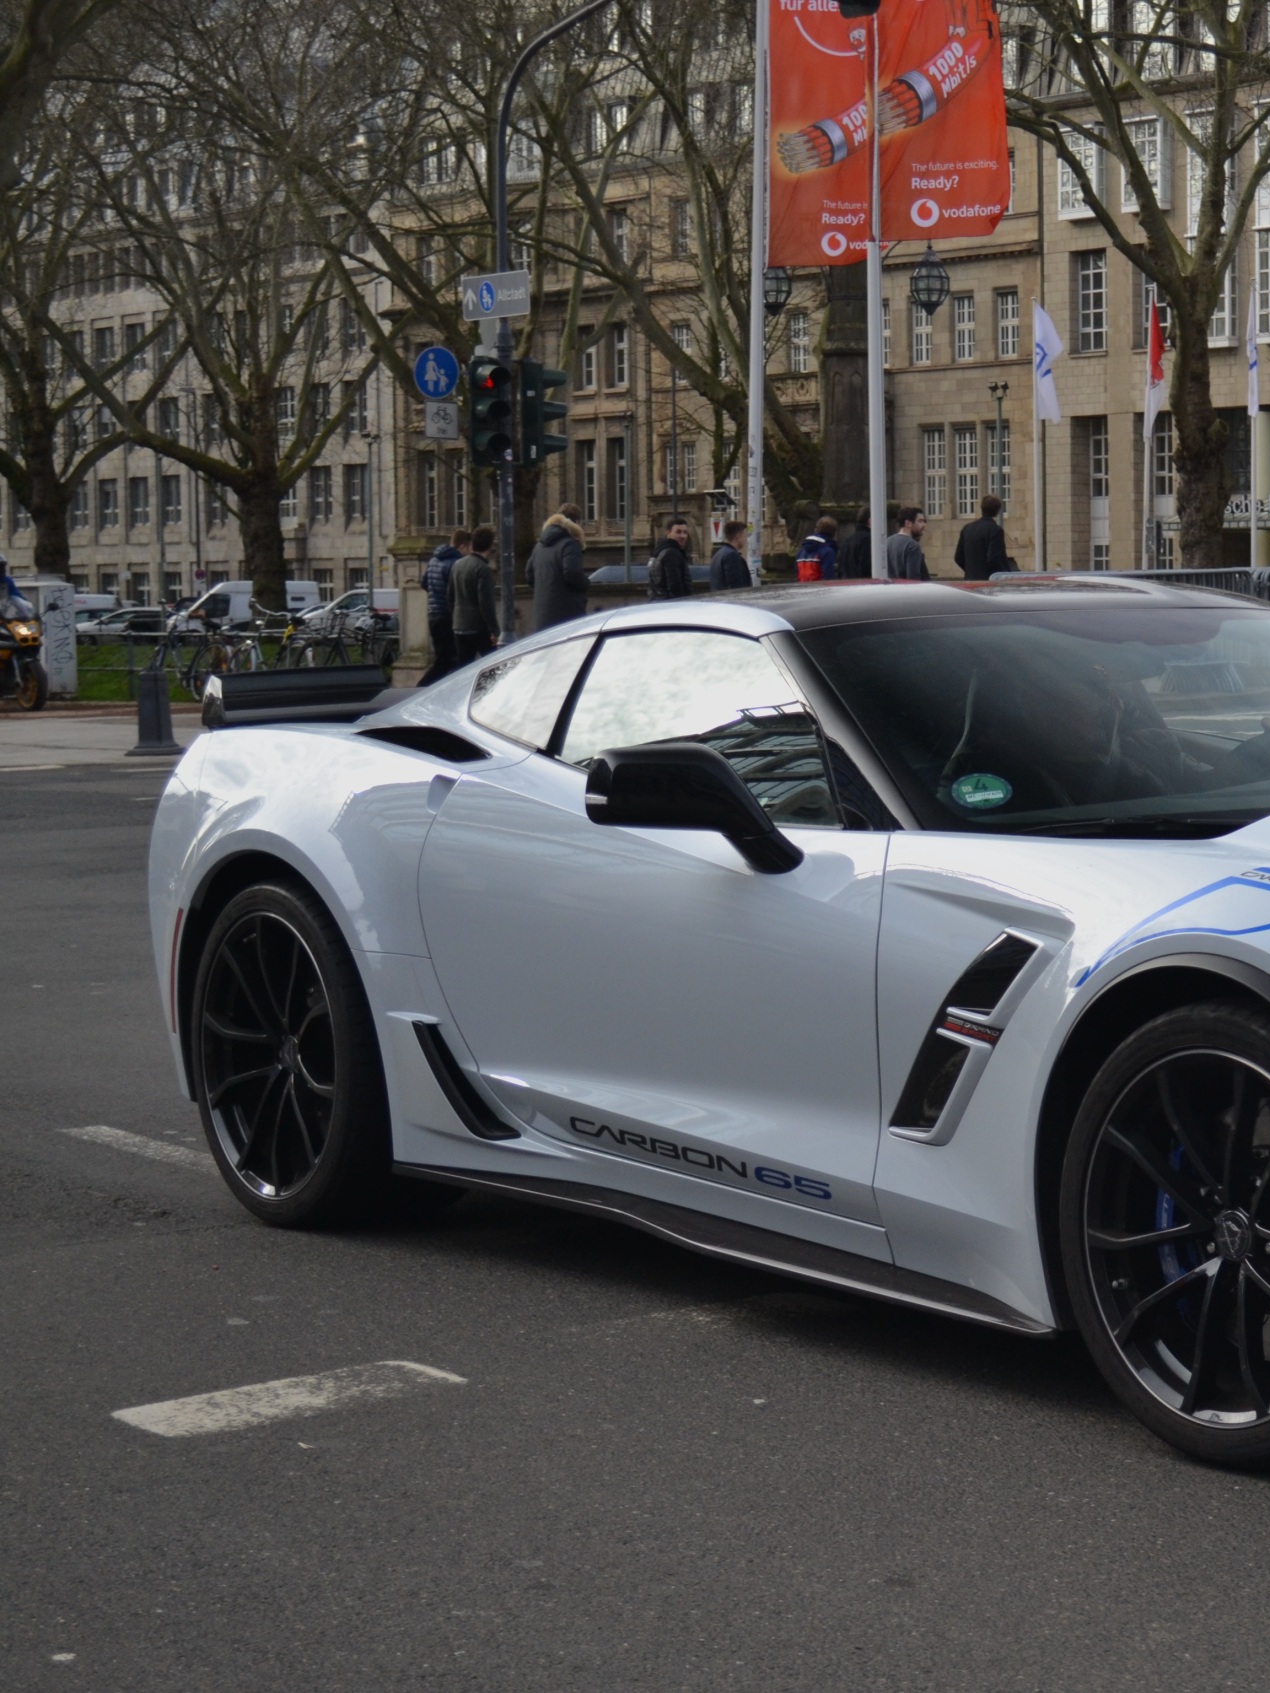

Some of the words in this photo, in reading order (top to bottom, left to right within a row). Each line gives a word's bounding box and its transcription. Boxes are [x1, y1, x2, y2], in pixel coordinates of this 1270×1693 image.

[807, 0, 841, 12] alle
[928, 41, 964, 81] 1000
[941, 54, 977, 98] Mbit/s
[911, 163, 927, 172] The
[929, 162, 954, 171] future
[956, 161, 963, 169] is
[964, 160, 999, 170] exciting.
[911, 176, 959, 191] Ready?
[823, 200, 836, 209] The
[837, 200, 862, 210] future
[942, 204, 1001, 218] vodafone
[821, 213, 865, 226] Ready?
[974, 778, 988, 791] 4
[570, 1116, 748, 1179] CARBON
[754, 1166, 832, 1200] 65
